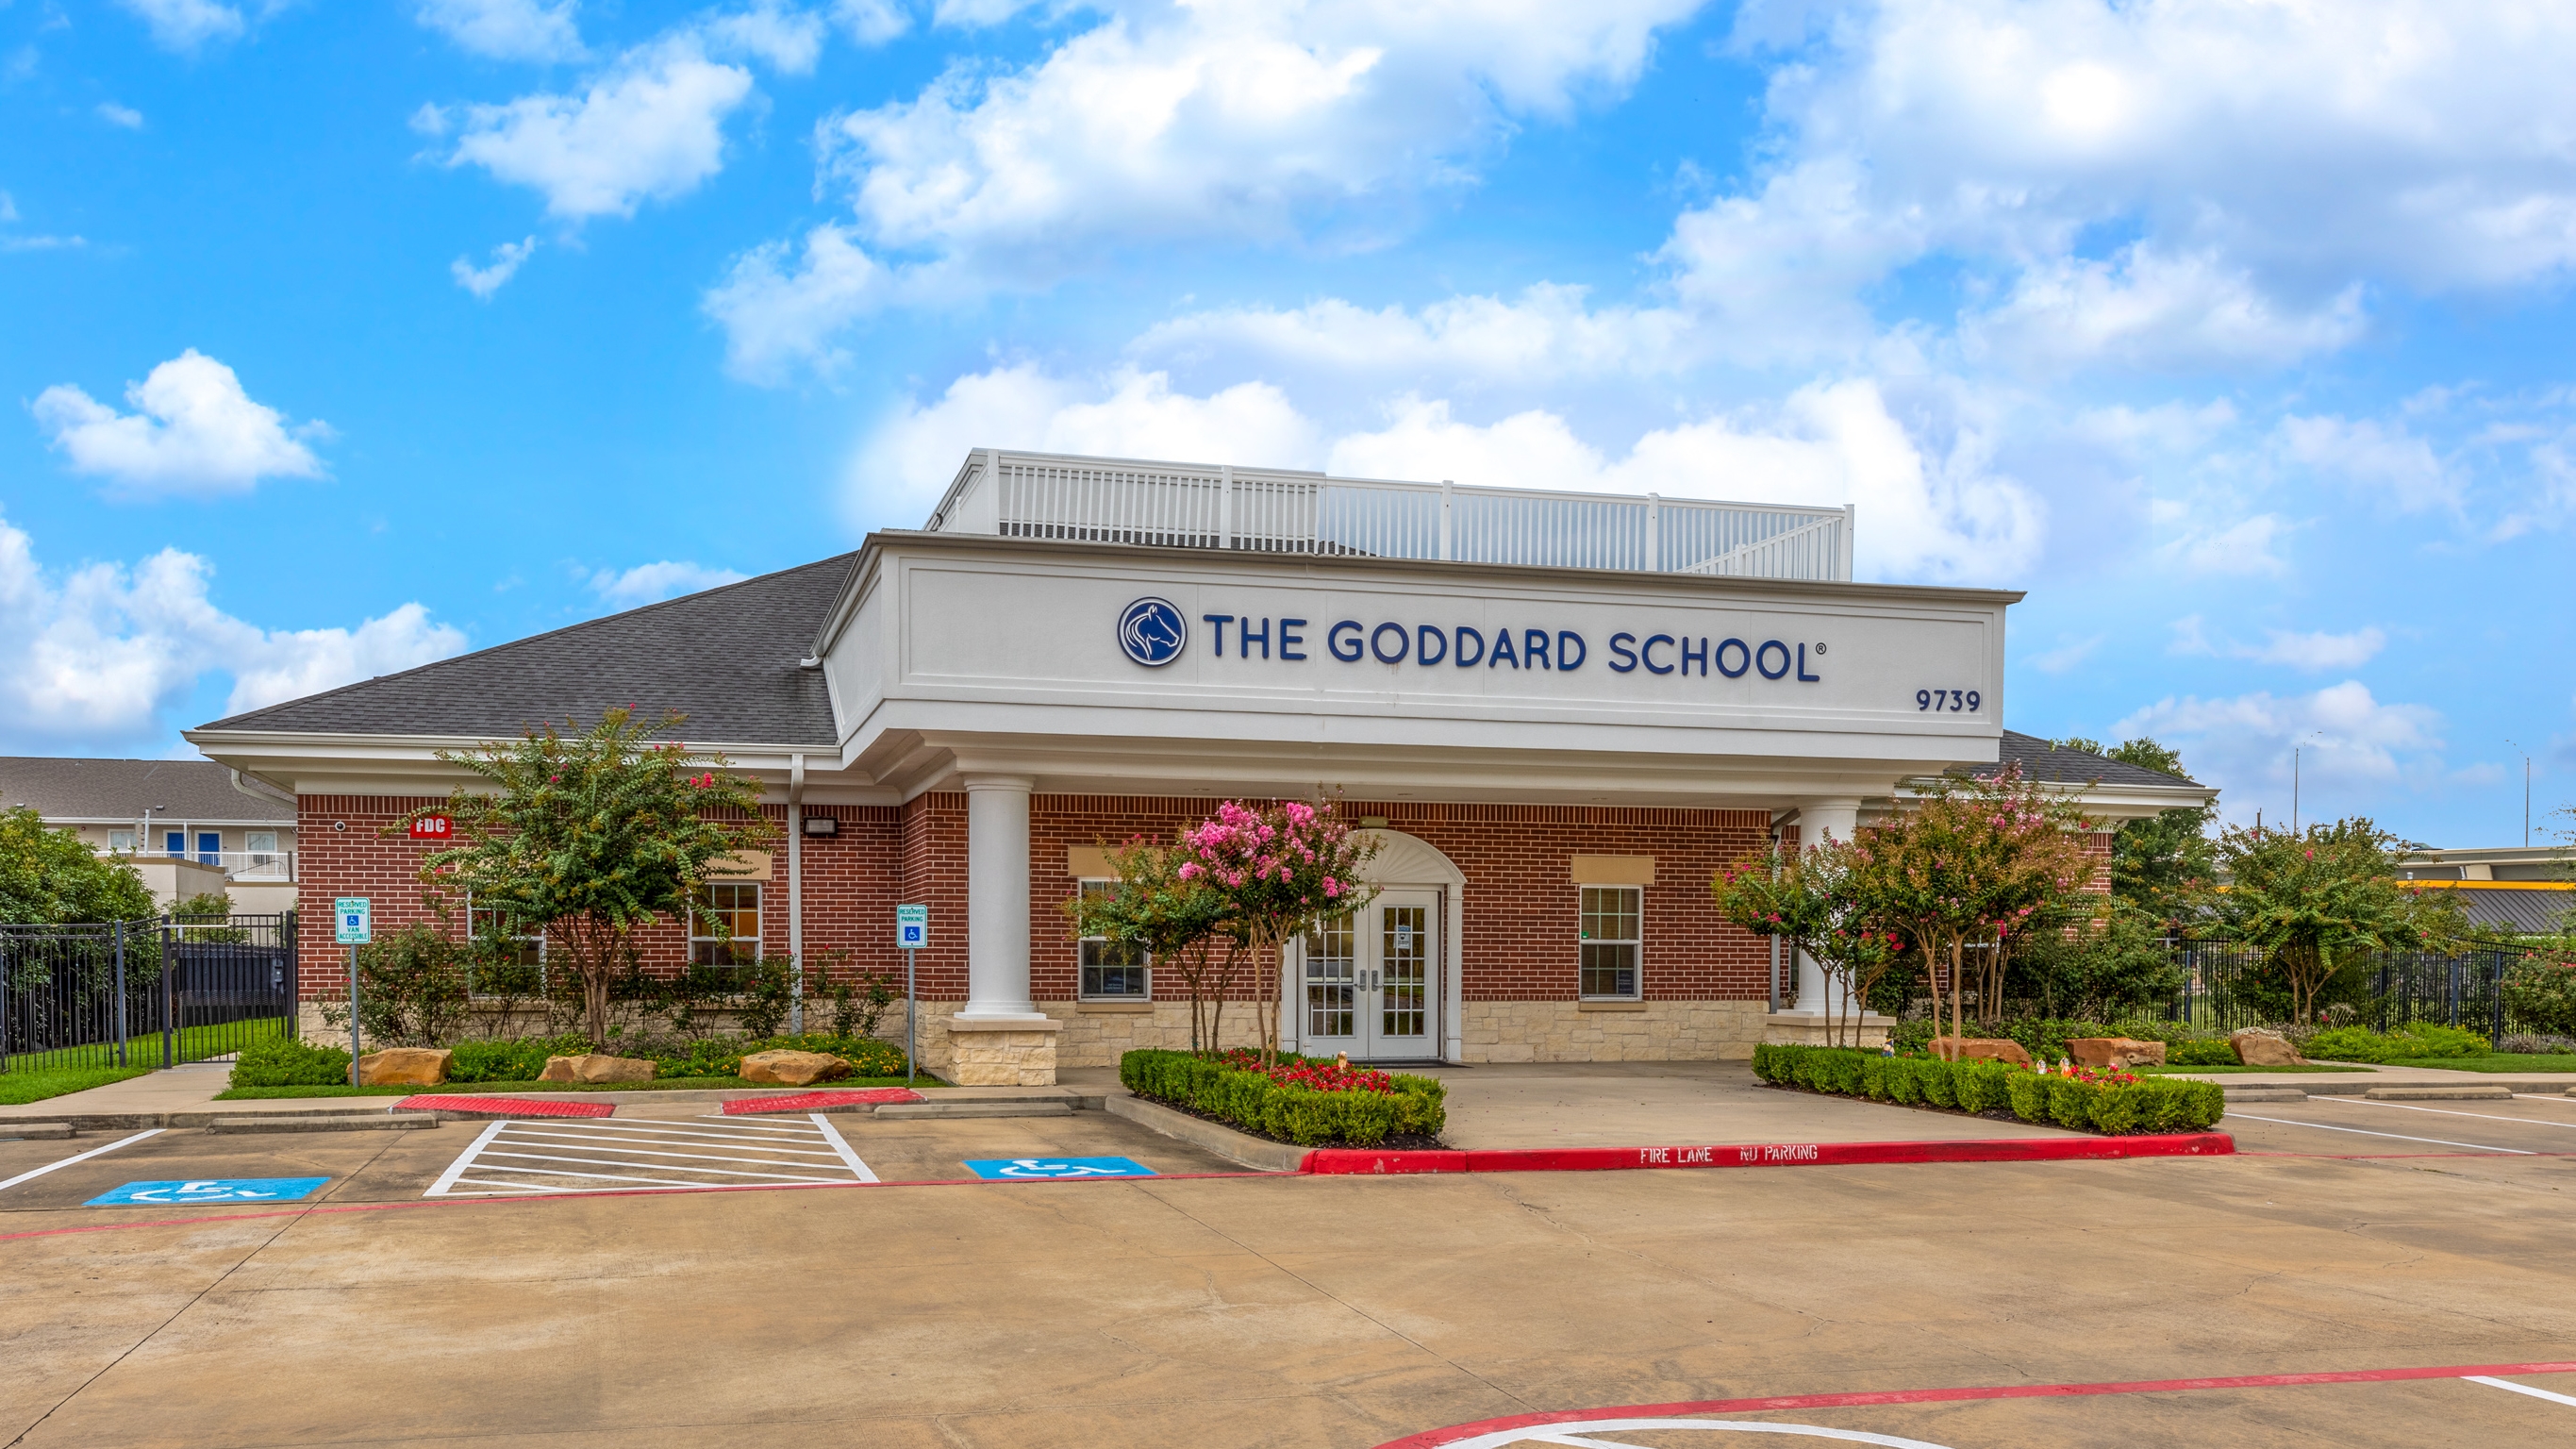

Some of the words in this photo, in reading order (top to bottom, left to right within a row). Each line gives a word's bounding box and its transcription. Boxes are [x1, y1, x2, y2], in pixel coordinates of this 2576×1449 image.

[1203, 614, 1307, 660] THE
[1327, 620, 1587, 672] GODDARD
[1916, 689, 1981, 712] 9739
[416, 818, 445, 833] FDC
[1639, 1147, 1670, 1164] FIRE
[1677, 1146, 1713, 1163] LANE
[1764, 1144, 1819, 1161] PARKING
